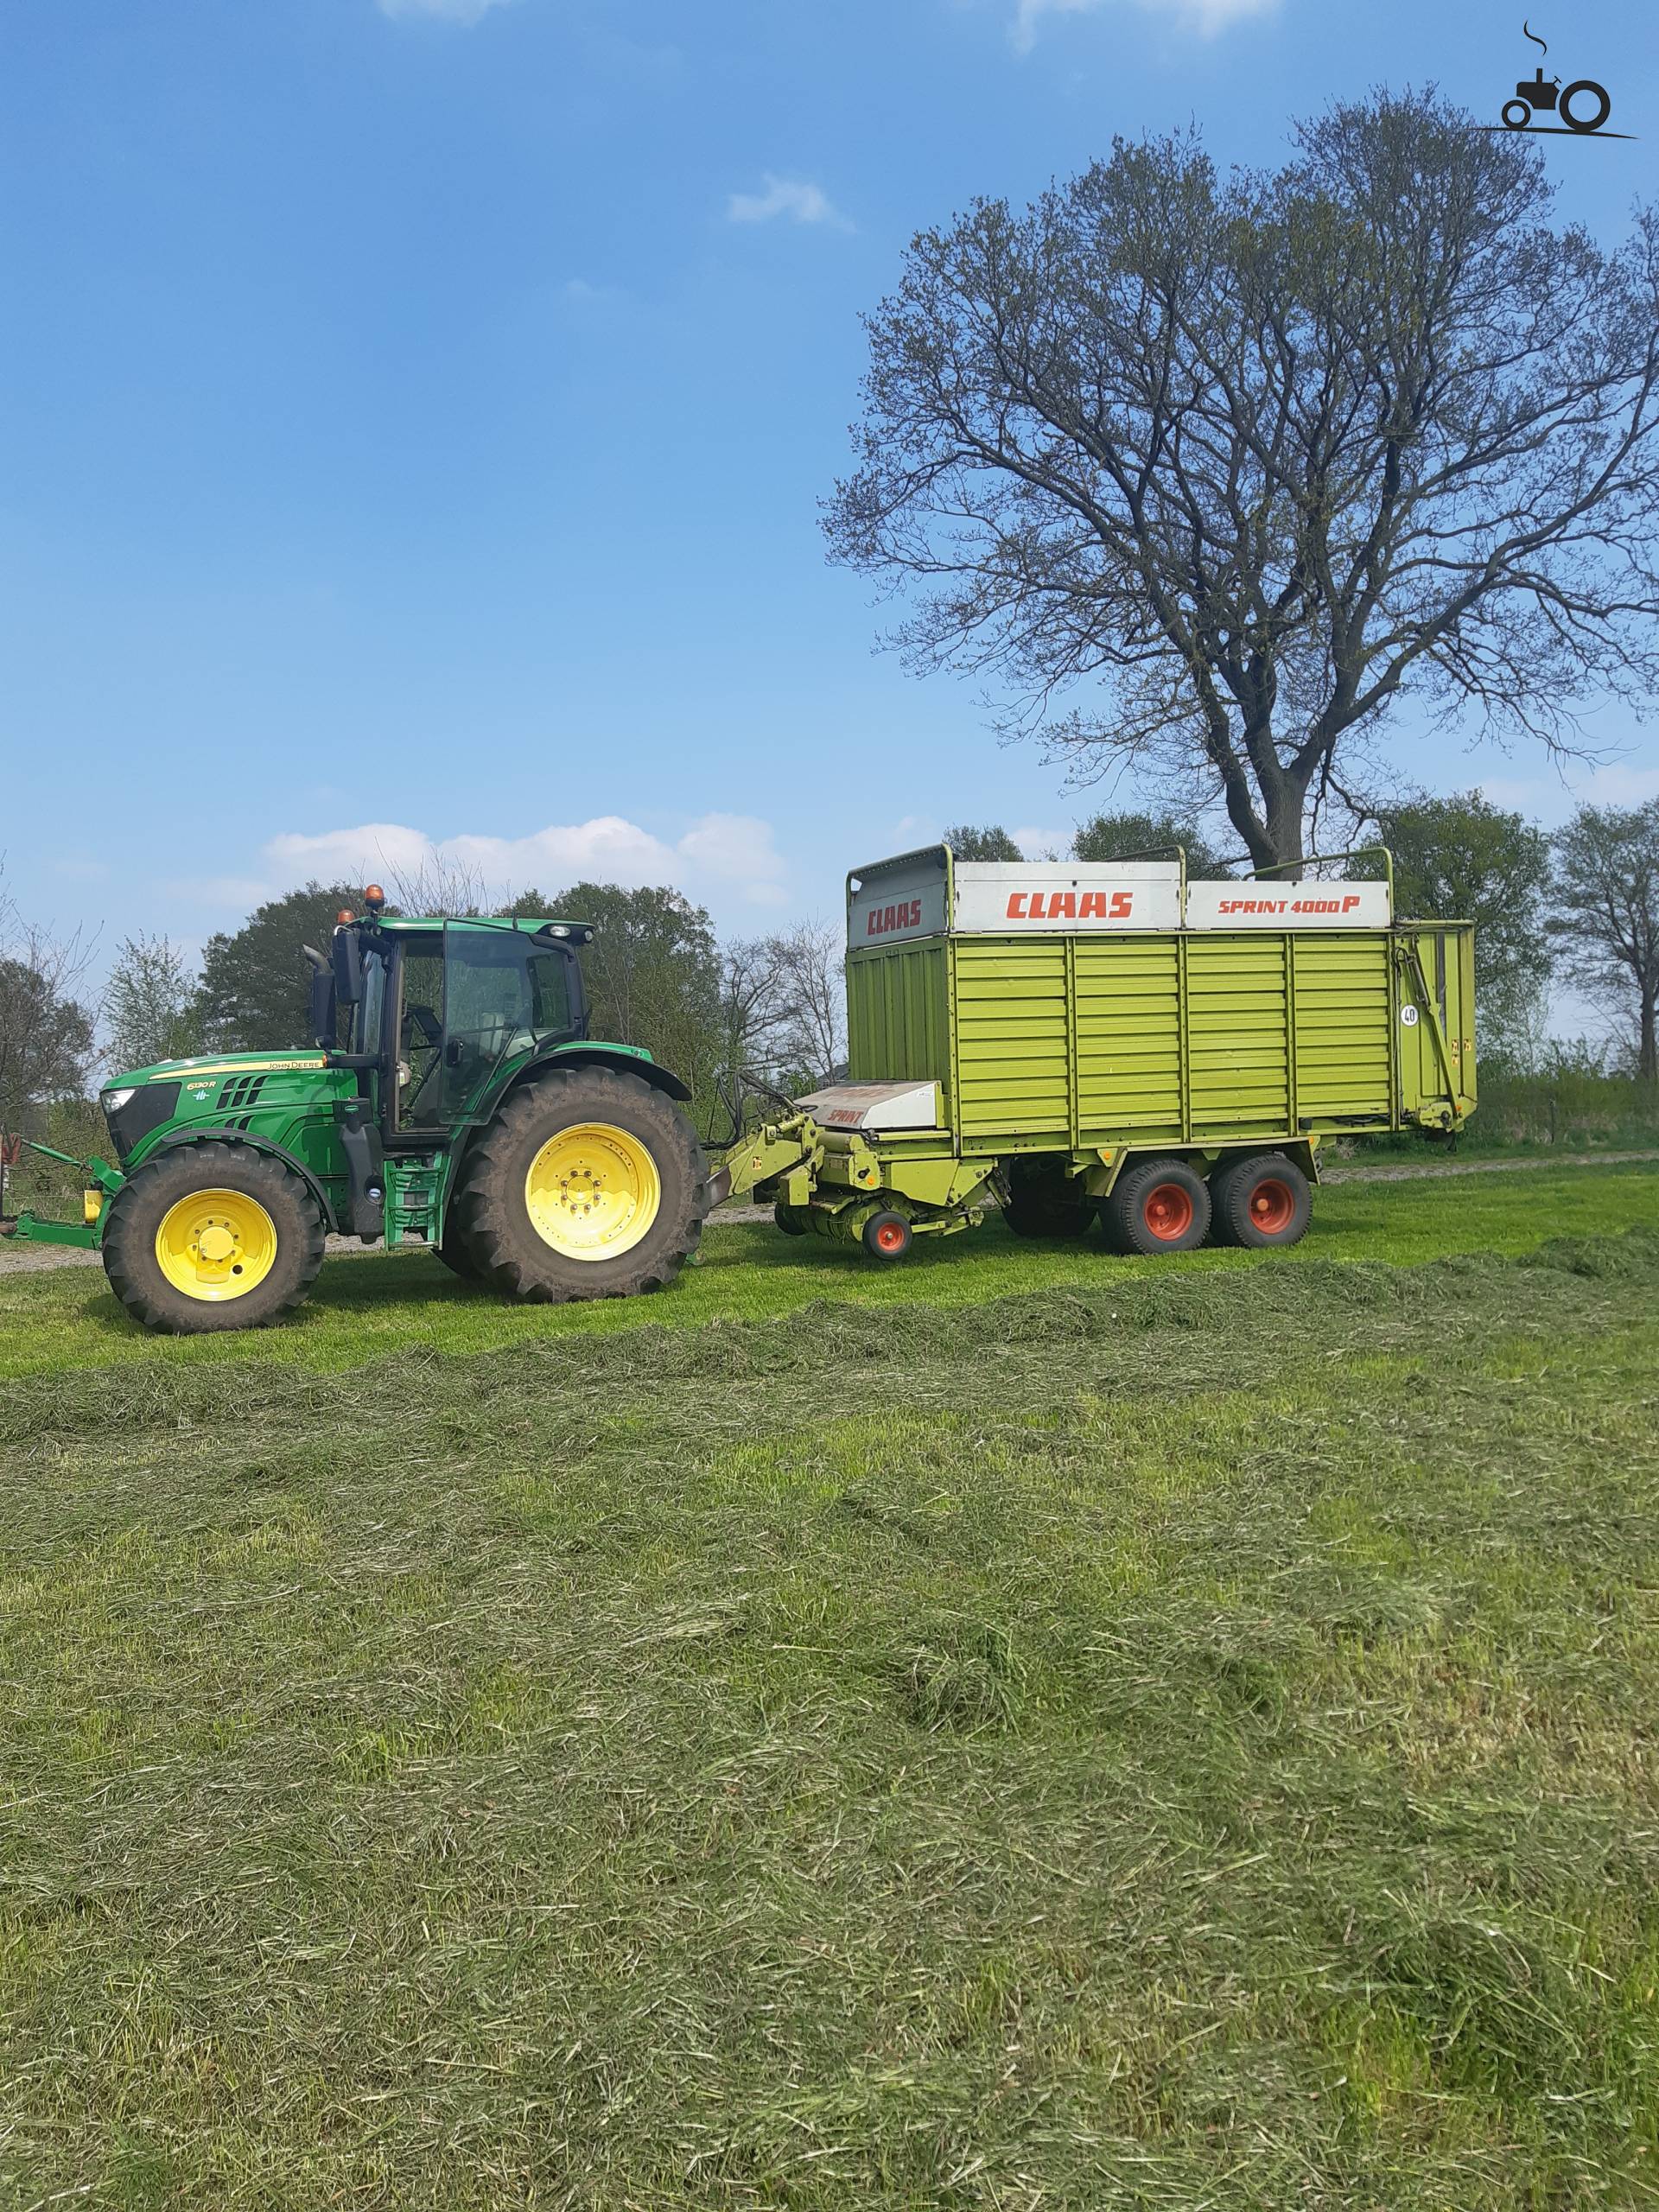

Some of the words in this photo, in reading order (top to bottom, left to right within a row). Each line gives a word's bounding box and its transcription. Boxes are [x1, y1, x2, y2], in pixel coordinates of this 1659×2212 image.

[1006, 892, 1135, 919] CLAAS
[1217, 900, 1288, 914] SPRINT
[867, 899, 922, 936] CLAAS
[1404, 1008, 1415, 1023] 40
[828, 1109, 864, 1124] SPRINT
